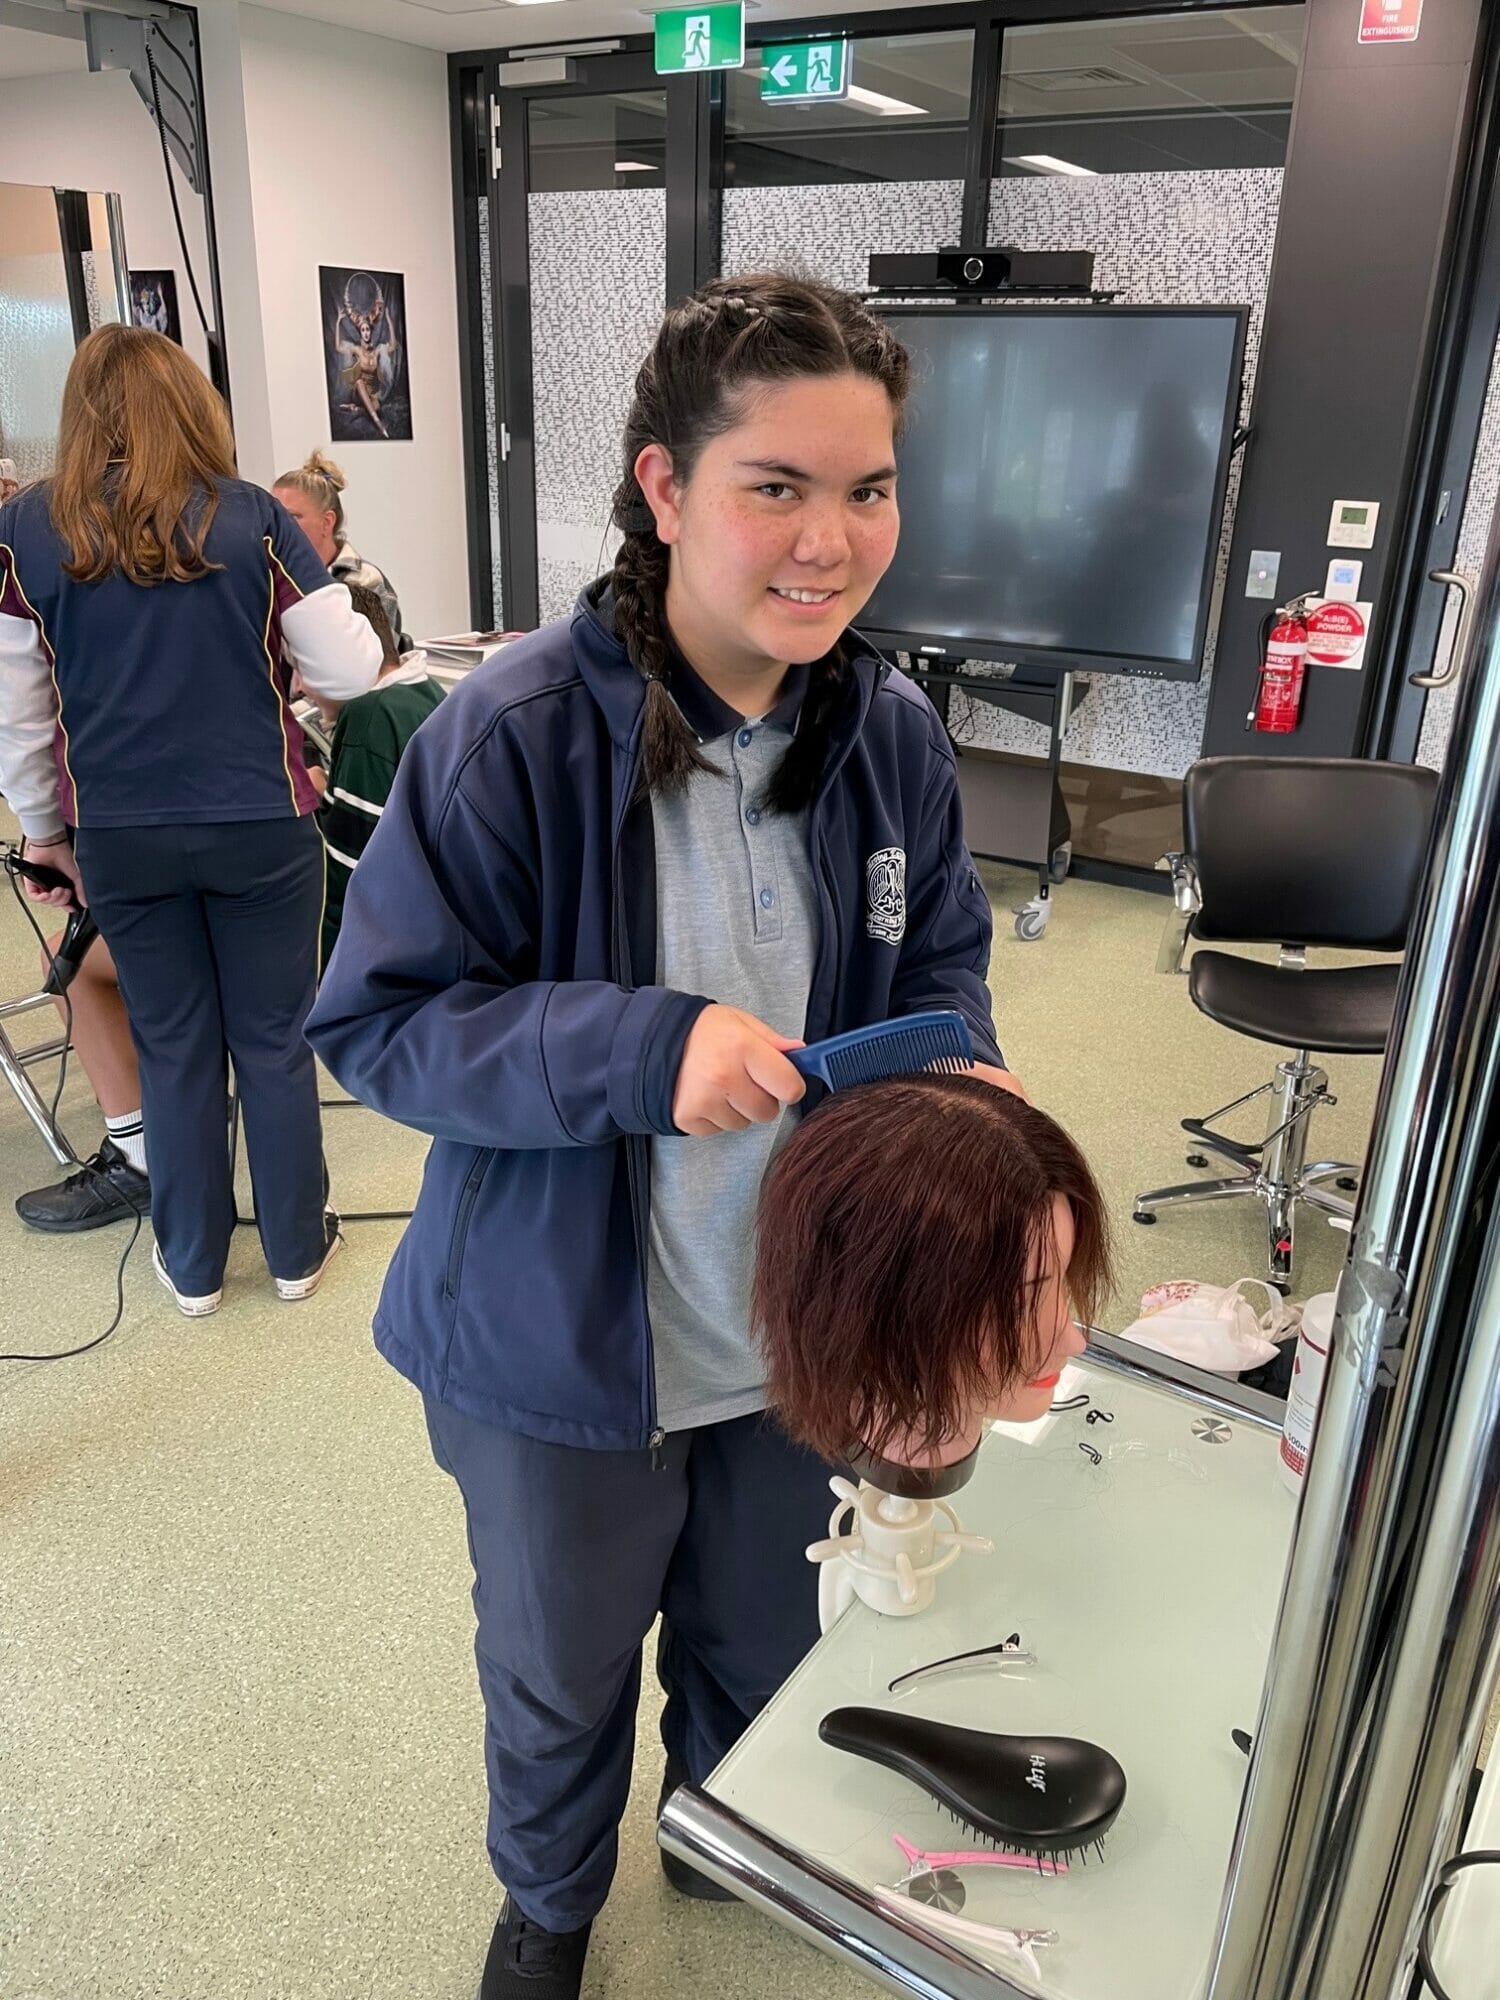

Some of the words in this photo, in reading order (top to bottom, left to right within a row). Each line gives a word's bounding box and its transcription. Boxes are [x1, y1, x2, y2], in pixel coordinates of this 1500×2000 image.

[1382, 14, 1399, 24] FIRE
[1361, 25, 1416, 36] EXTINGUISHER
[1316, 622, 1353, 632] POWDER
